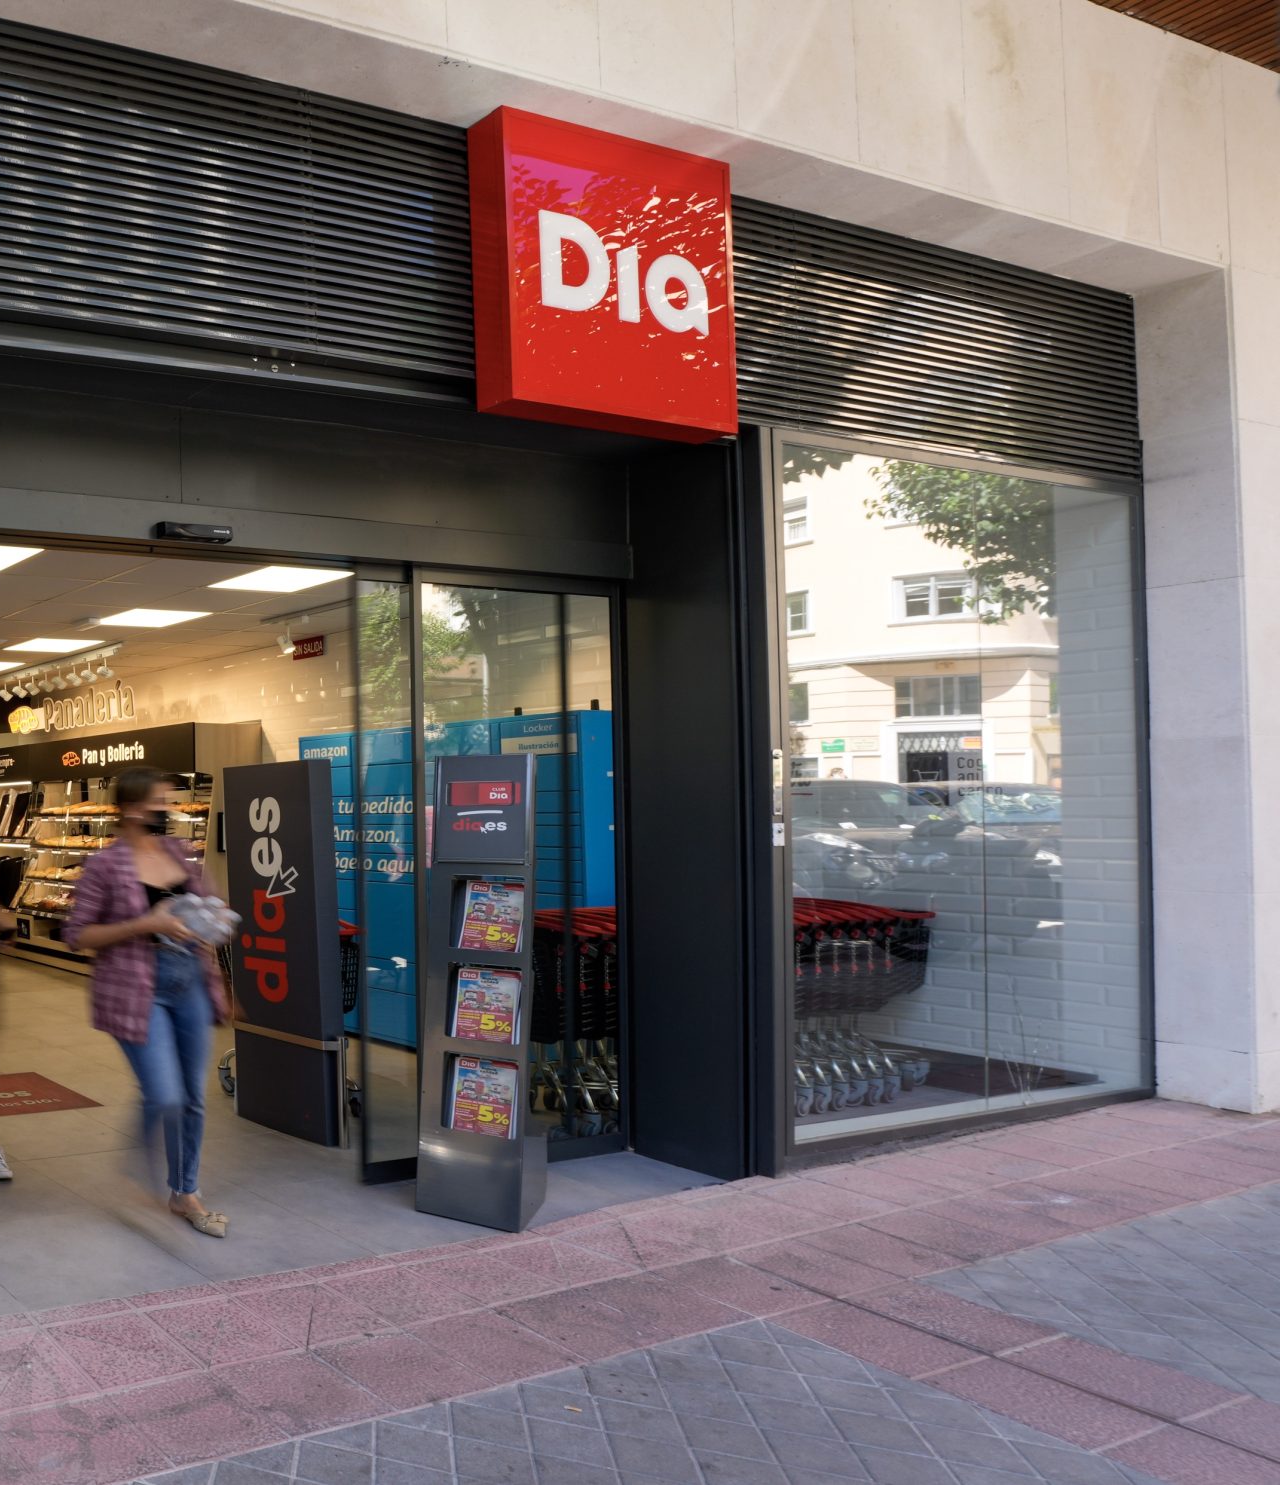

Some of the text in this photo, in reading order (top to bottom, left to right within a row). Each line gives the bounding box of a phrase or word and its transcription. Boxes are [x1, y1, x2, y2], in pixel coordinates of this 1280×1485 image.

[303, 640, 323, 655] SALIDA
[42, 680, 136, 732] Panadería
[523, 723, 553, 733] Locker
[82, 740, 144, 767] Pan y Bollería
[303, 745, 348, 759] amazon
[338, 799, 354, 814] tu
[486, 926, 517, 944] 5%
[480, 1014, 512, 1033] 5%
[476, 1105, 510, 1125] 5%
